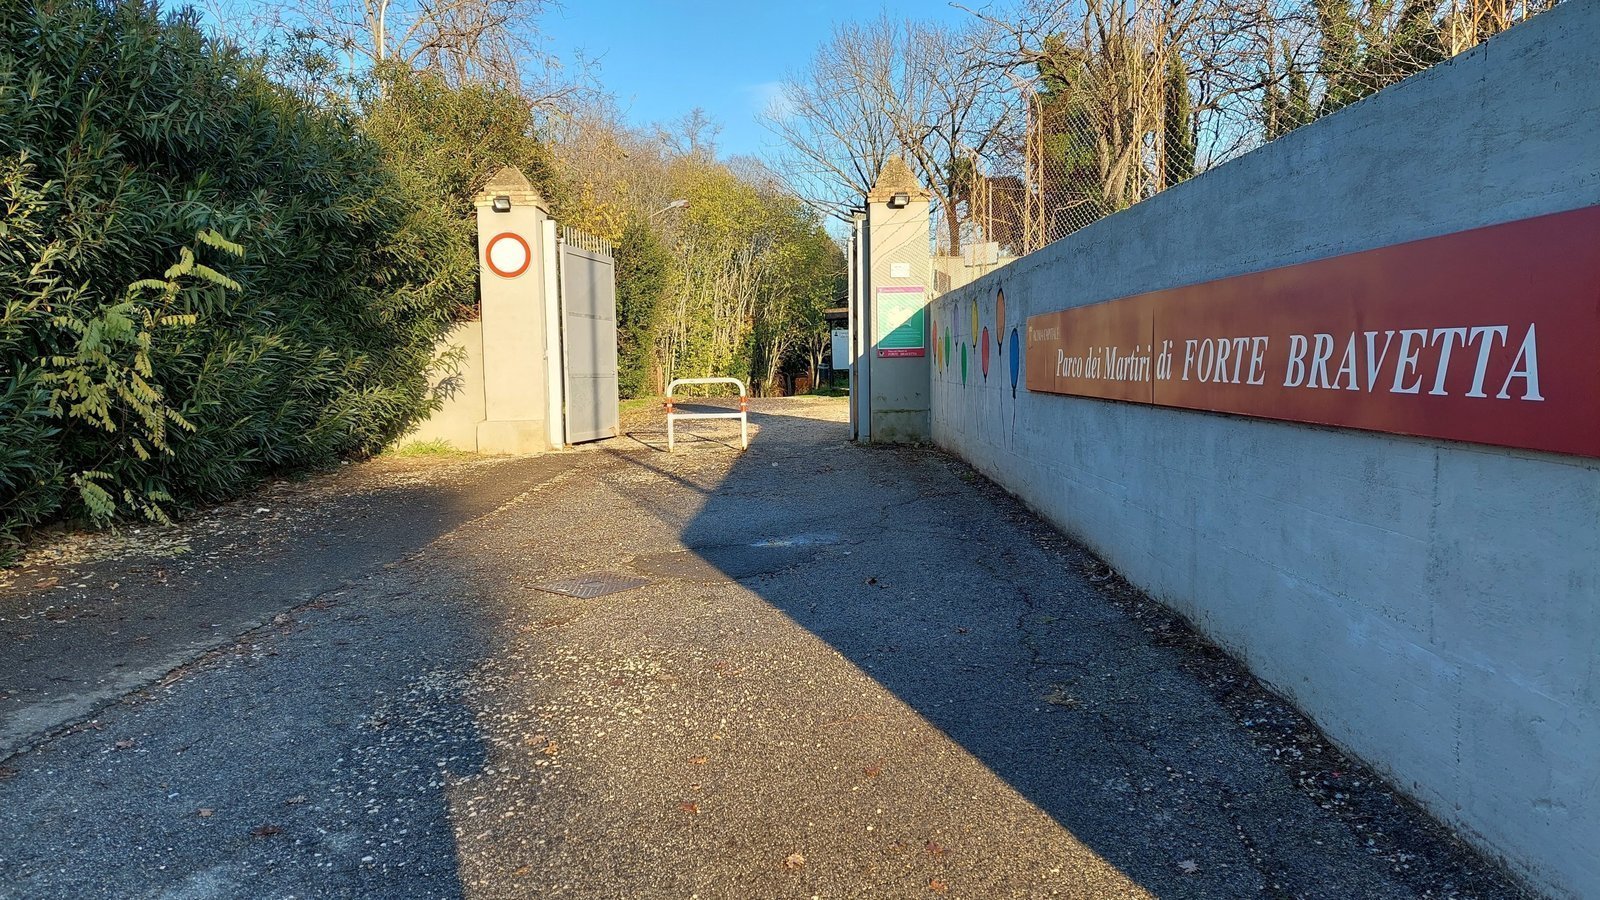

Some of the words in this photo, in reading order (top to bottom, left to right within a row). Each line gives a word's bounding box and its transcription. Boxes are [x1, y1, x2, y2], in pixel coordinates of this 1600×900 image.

[1056, 349, 1082, 377] Parco
[1085, 347, 1101, 379] dei
[1103, 345, 1151, 382] Martiri
[1157, 340, 1173, 380] di
[1182, 336, 1269, 385] FORTE
[1283, 323, 1545, 401] BRAVETTA
